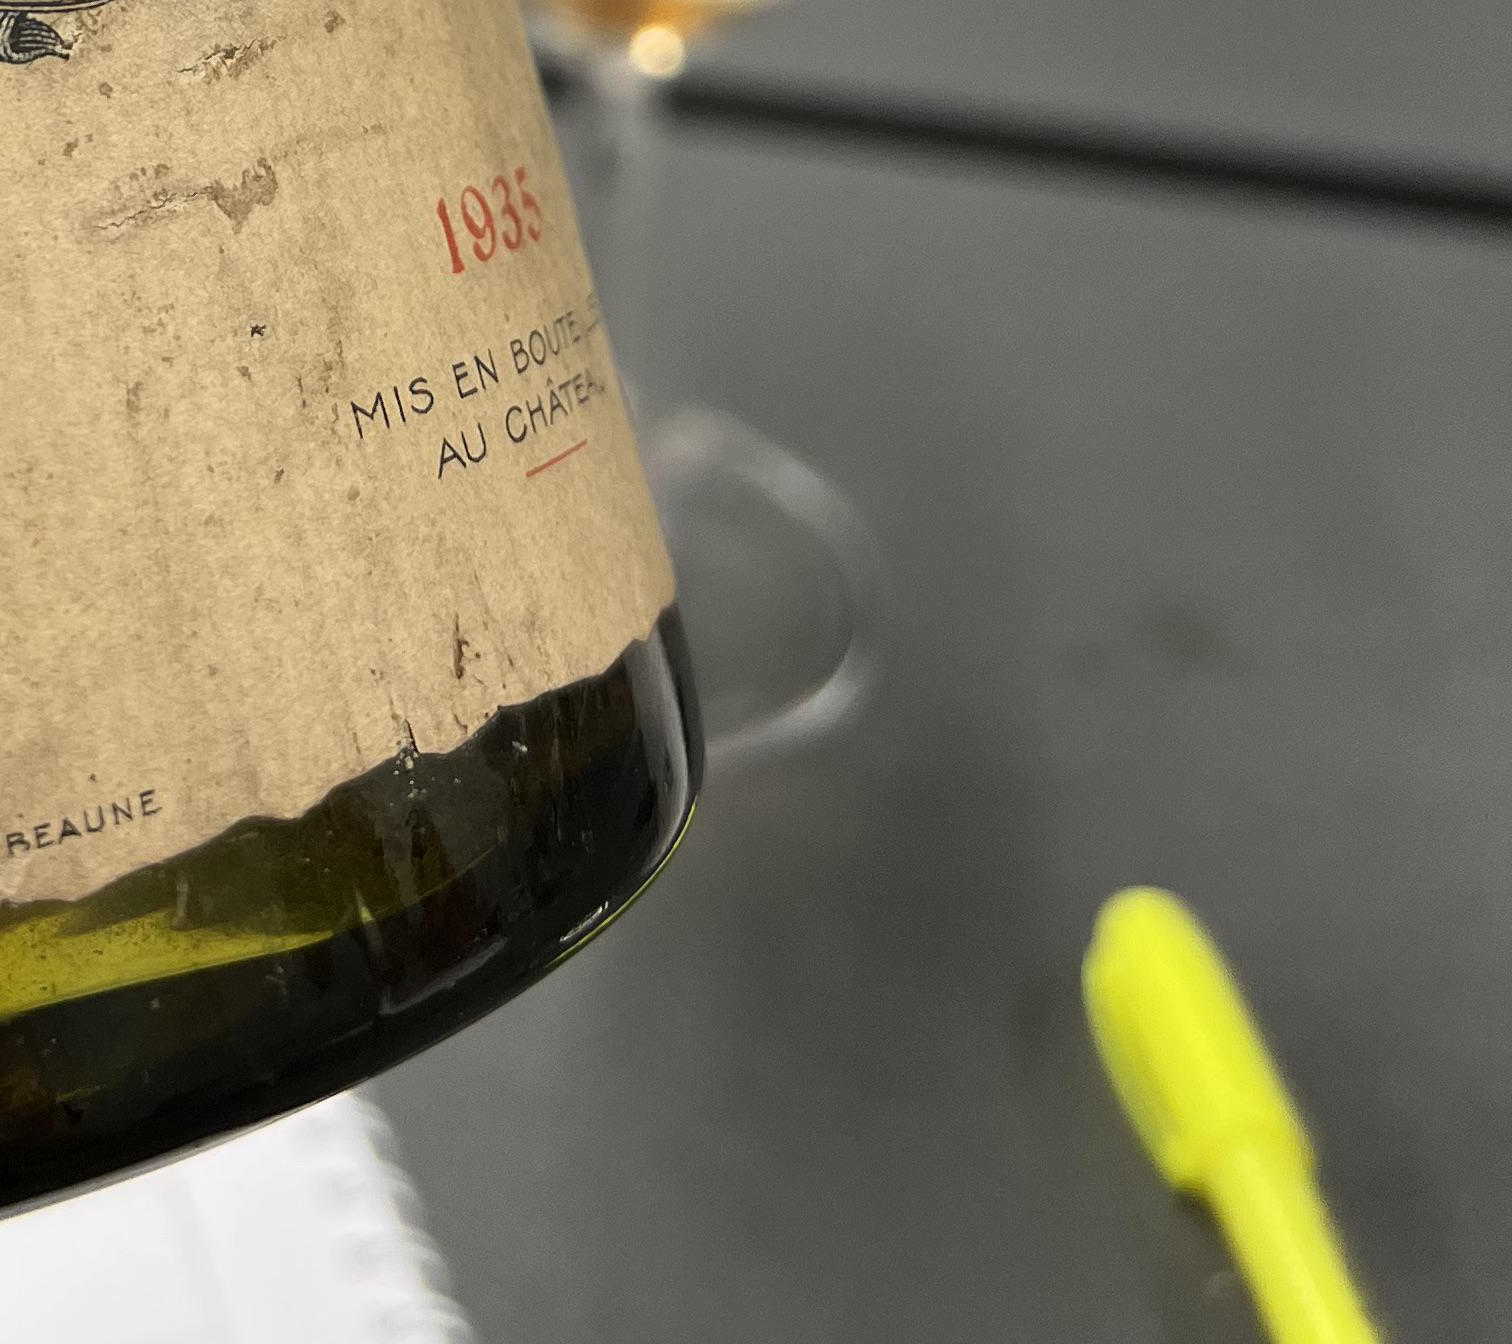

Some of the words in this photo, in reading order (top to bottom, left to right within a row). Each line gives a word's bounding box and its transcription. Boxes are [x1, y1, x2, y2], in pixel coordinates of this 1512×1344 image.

[436, 165, 542, 274] 1935
[351, 377, 434, 439] MIS
[452, 349, 498, 399] EN
[438, 423, 487, 480] AU
[505, 367, 606, 443] CHÂTEA
[5, 789, 163, 856] BEAUNE
